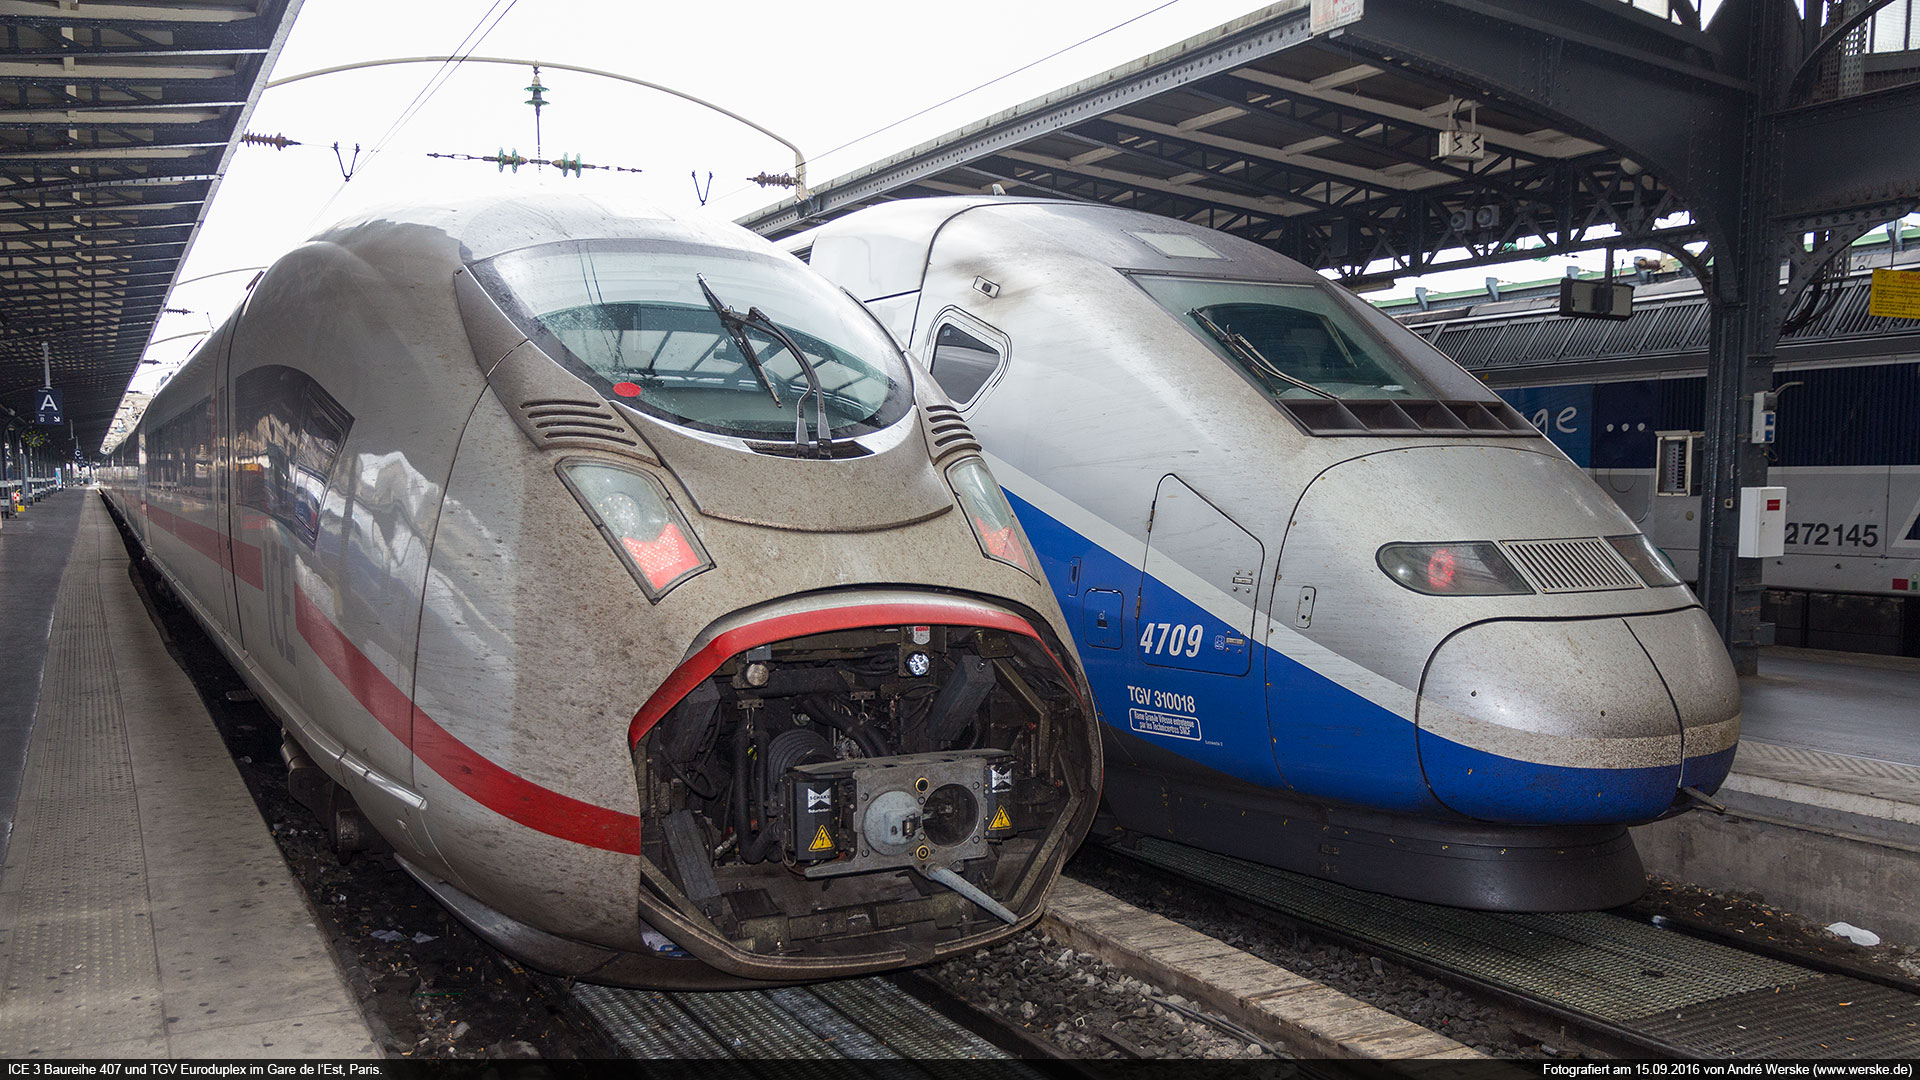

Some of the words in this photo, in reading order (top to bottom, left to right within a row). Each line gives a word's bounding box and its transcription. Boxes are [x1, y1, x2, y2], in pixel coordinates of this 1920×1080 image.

[41, 394, 58, 411] A
[1784, 522, 1878, 547] 272145
[1140, 622, 1203, 658] 4709
[1127, 685, 1151, 705] TGV
[1154, 690, 1196, 713] 310018
